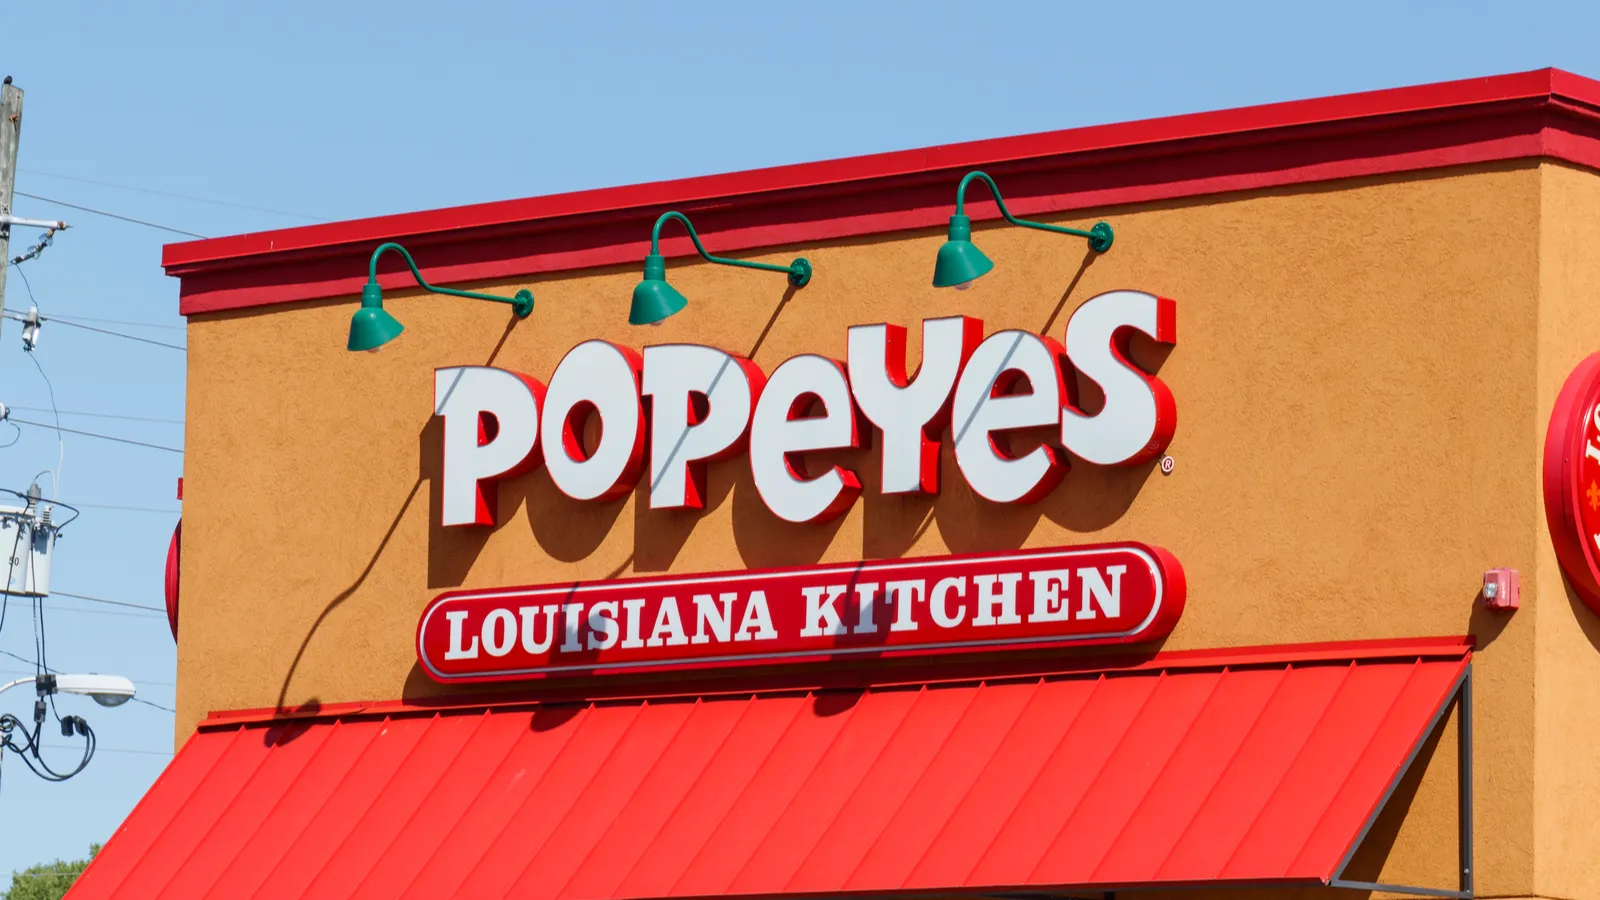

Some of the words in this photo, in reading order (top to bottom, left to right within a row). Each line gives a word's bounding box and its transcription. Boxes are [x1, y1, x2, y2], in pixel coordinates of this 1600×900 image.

[8, 556, 20, 567] 50
[443, 589, 778, 661] LOUISIANA
[800, 562, 1127, 638] KITCHEN
